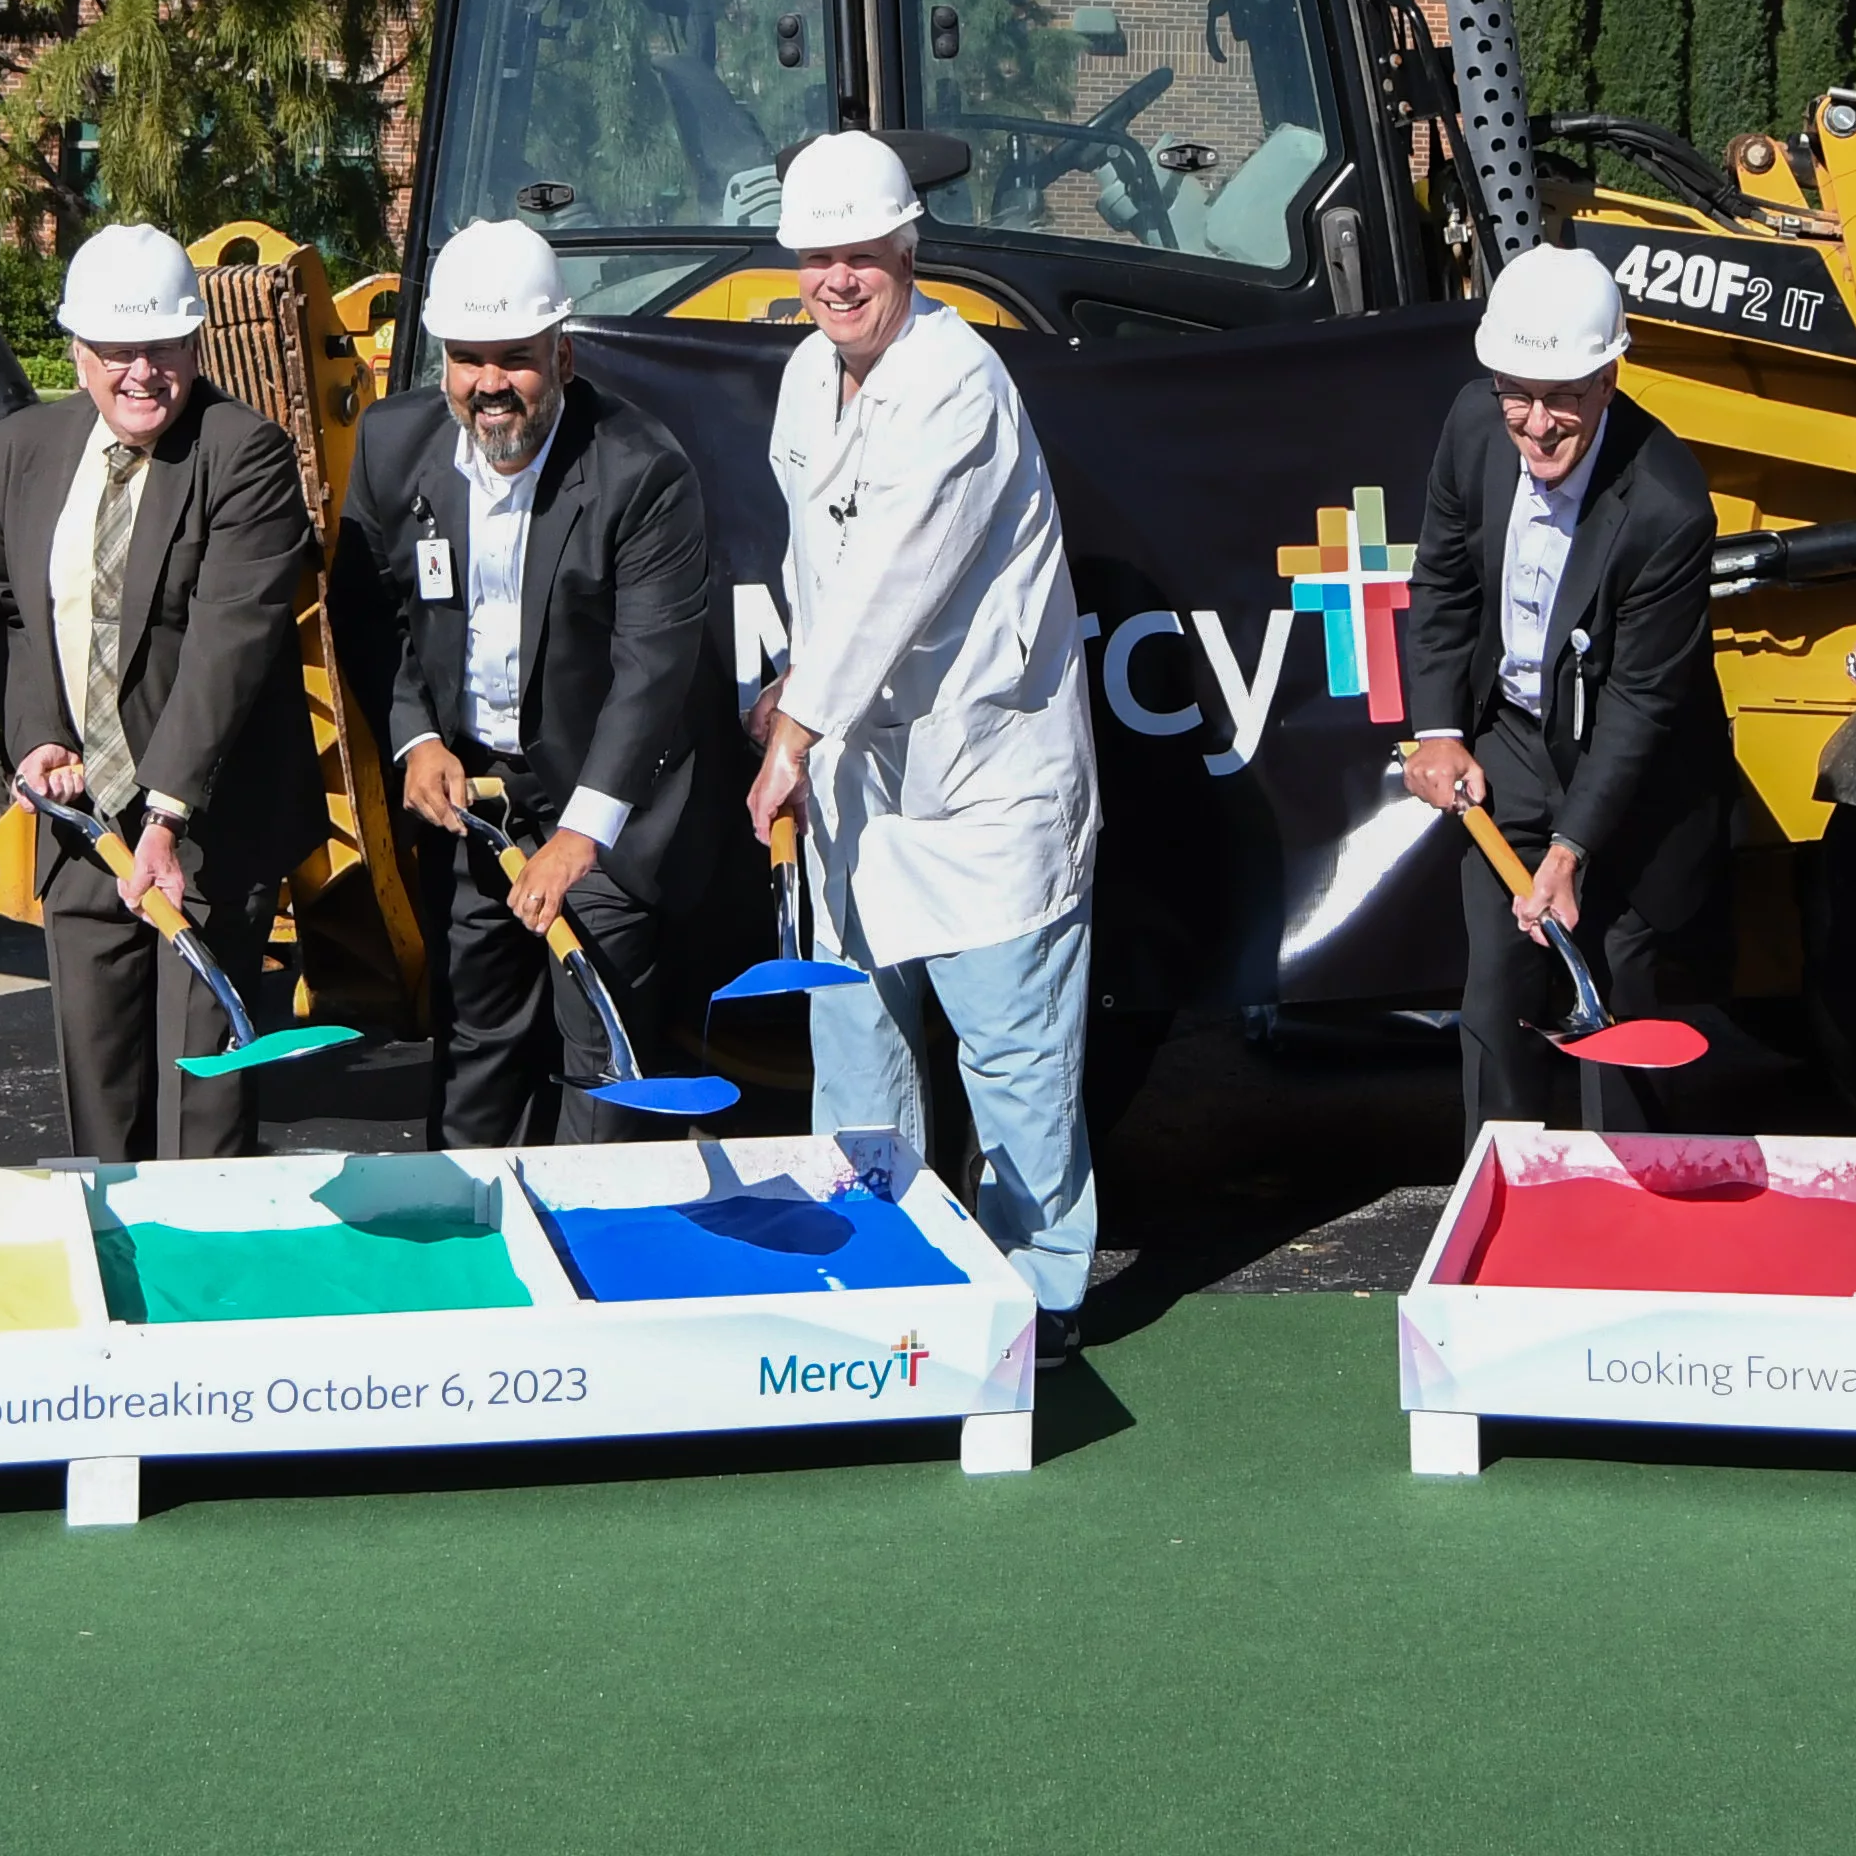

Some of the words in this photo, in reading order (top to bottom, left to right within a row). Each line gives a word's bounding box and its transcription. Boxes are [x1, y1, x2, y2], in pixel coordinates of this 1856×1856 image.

[114, 303, 150, 315] Mercy
[464, 302, 500, 313] Mercy
[1780, 287, 1825, 332] IT
[1514, 332, 1548, 351] Mercy
[266, 1374, 430, 1414] October
[441, 1372, 474, 1413] 6,
[487, 1367, 588, 1405] 2023
[759, 1354, 892, 1399] Mercy
[1587, 1348, 1733, 1396] Looking
